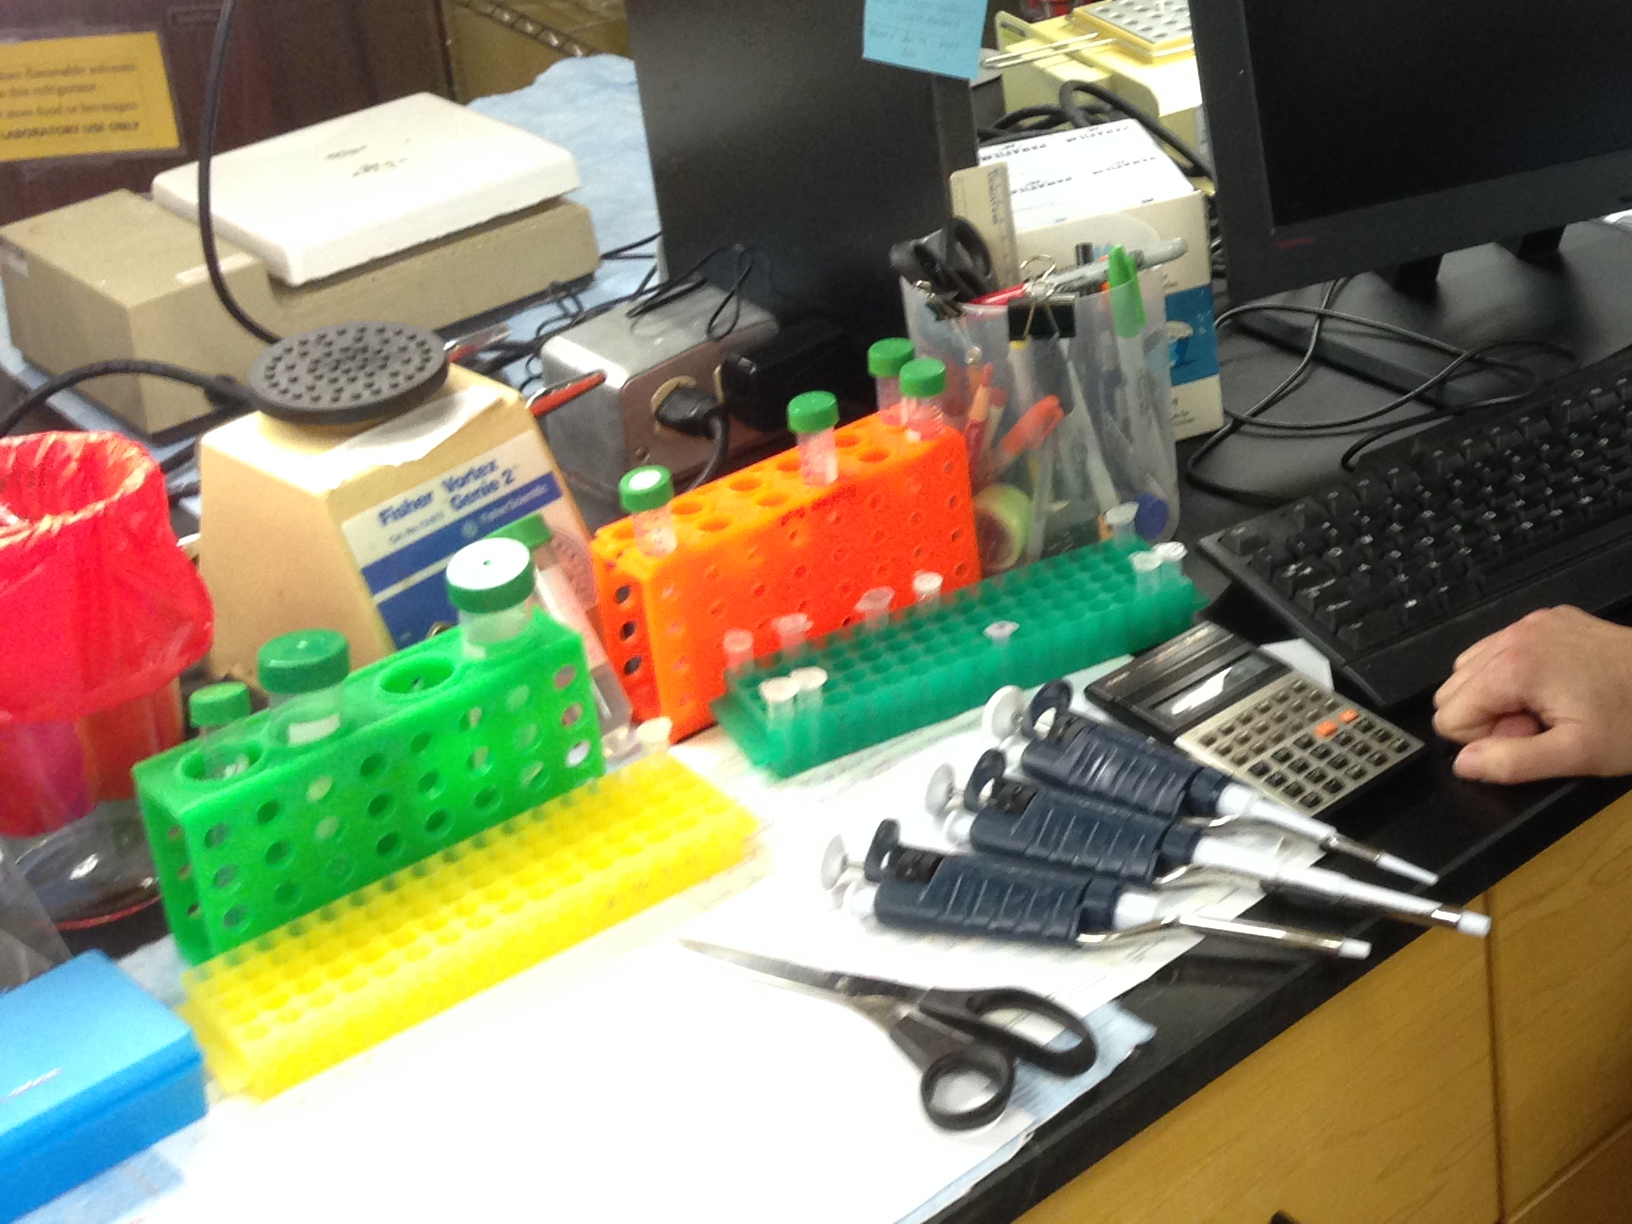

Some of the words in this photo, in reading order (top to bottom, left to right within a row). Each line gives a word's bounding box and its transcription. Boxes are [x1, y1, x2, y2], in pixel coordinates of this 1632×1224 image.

[377, 491, 434, 525] Fisher
[450, 480, 499, 511] Genie
[502, 469, 515, 485] 2
[442, 460, 498, 493] Vortex
